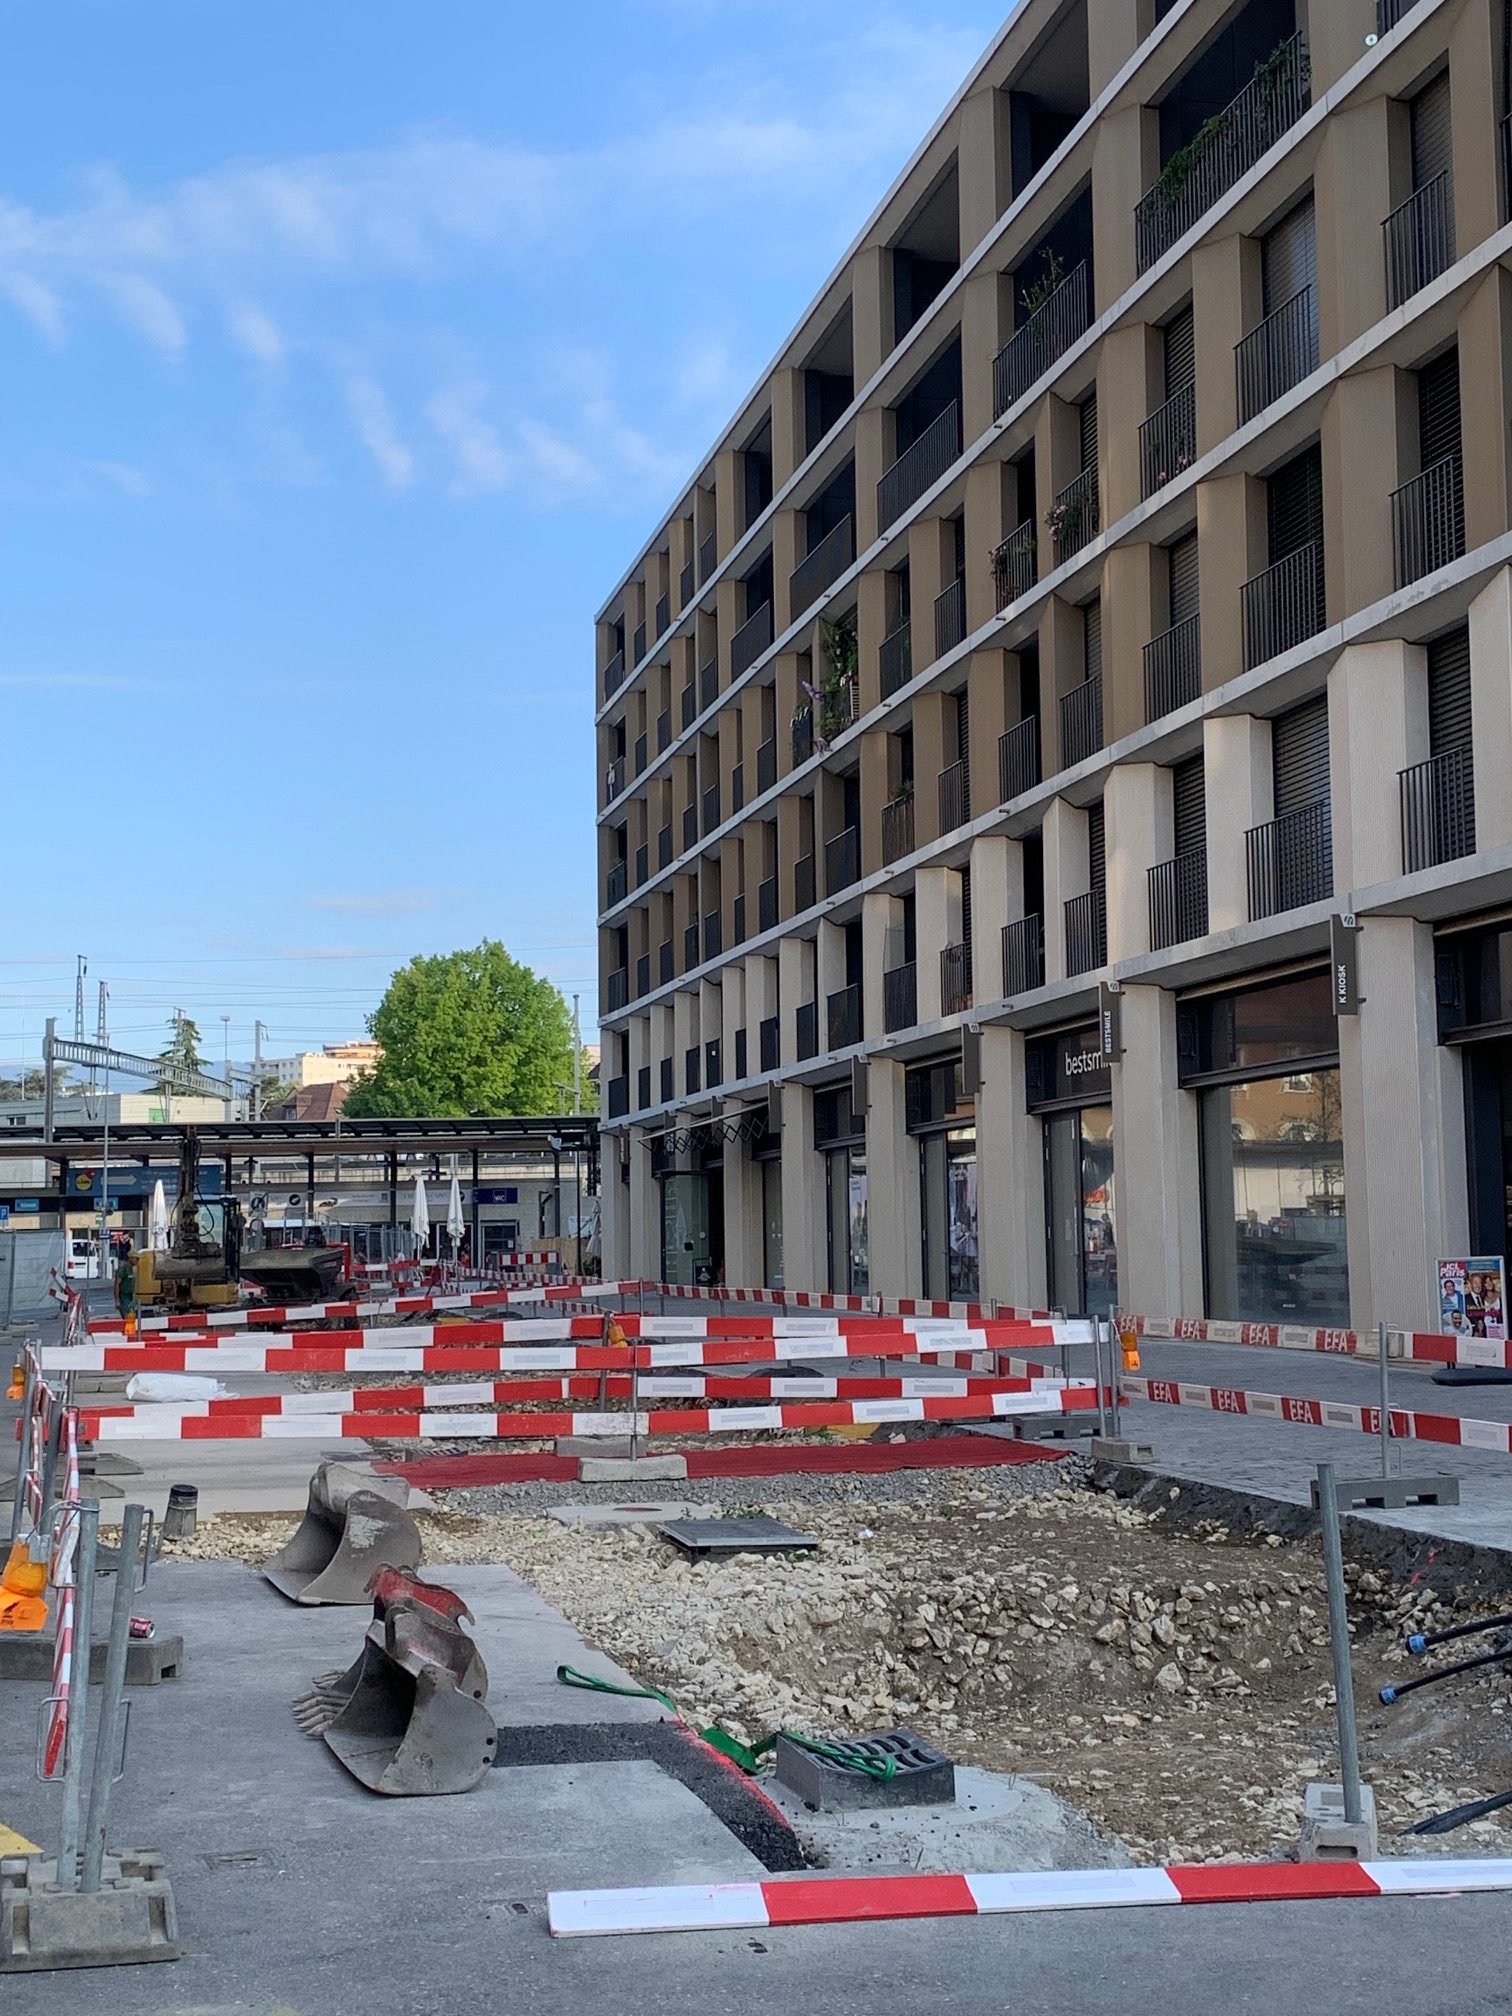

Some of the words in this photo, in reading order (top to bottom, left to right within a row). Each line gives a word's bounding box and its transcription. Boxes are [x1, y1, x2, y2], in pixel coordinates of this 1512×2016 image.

[1338, 965, 1347, 995] KIOSK
[1104, 1011, 1112, 1053] BESTSMILE
[1065, 1051, 1112, 1075] bestsm
